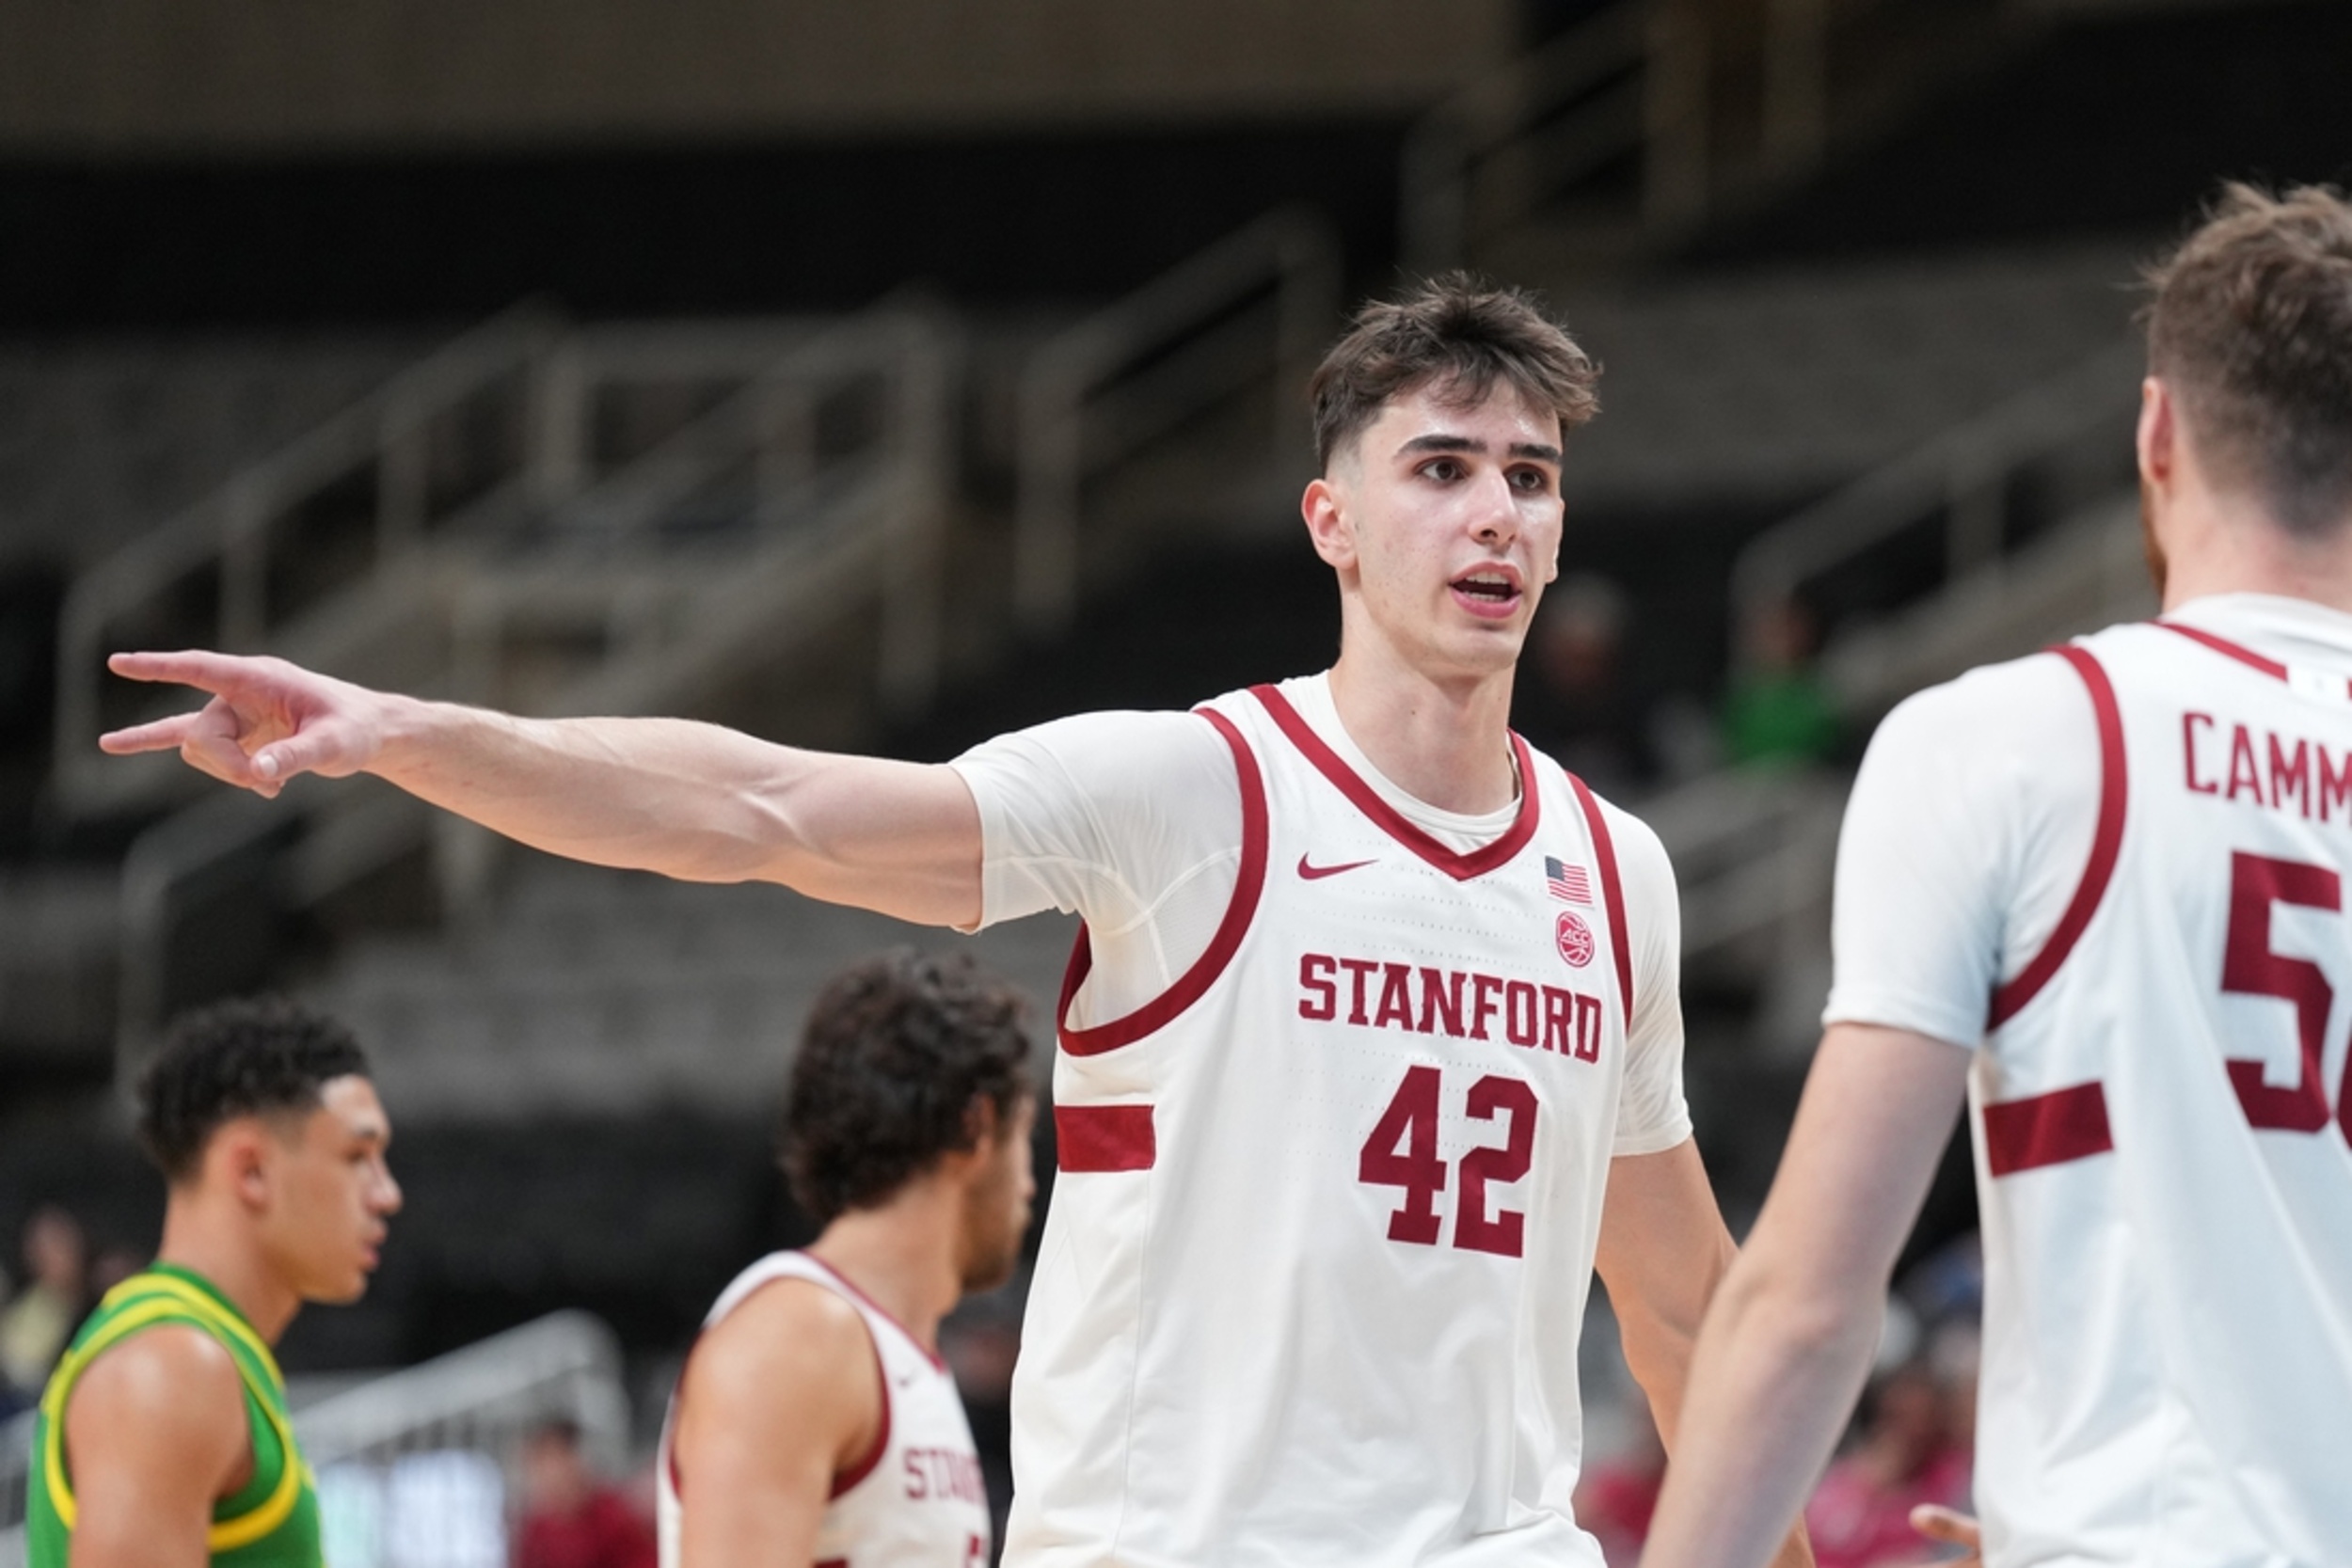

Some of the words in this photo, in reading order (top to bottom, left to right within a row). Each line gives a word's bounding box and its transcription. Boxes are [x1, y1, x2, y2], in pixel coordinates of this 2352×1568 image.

[1298, 953, 1602, 1064] STANFORD
[1561, 928, 1590, 948] ACC
[2219, 848, 2352, 1151] 5
[1358, 1065, 1538, 1258] 42
